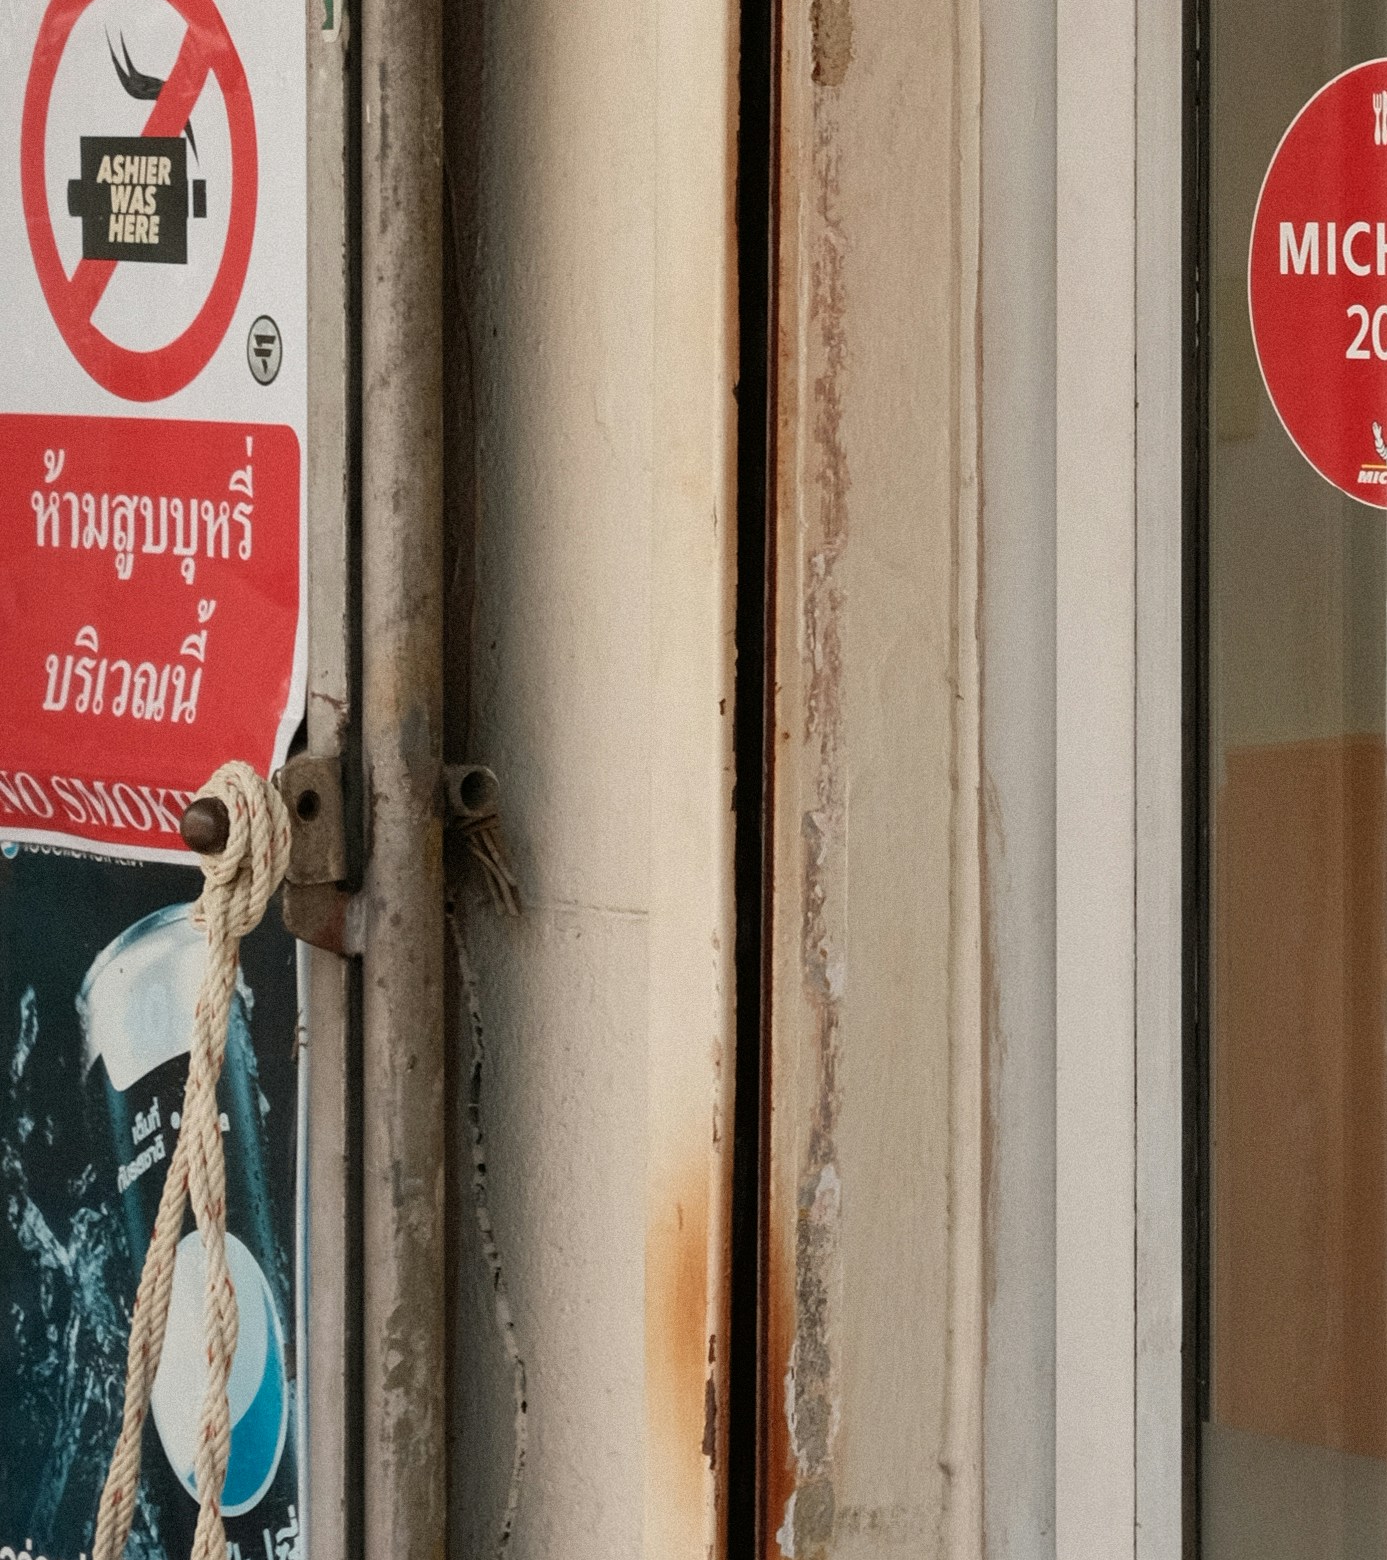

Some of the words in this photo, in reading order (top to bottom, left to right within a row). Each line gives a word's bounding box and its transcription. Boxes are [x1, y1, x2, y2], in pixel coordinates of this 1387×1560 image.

[96, 154, 173, 185] ASHIER
[110, 184, 157, 215] WAS
[108, 214, 160, 245] HERE
[30, 435, 255, 585] ห้ามสูบบุหรี่
[42, 598, 217, 724] บริเวณนี้
[0, 769, 55, 819] NO
